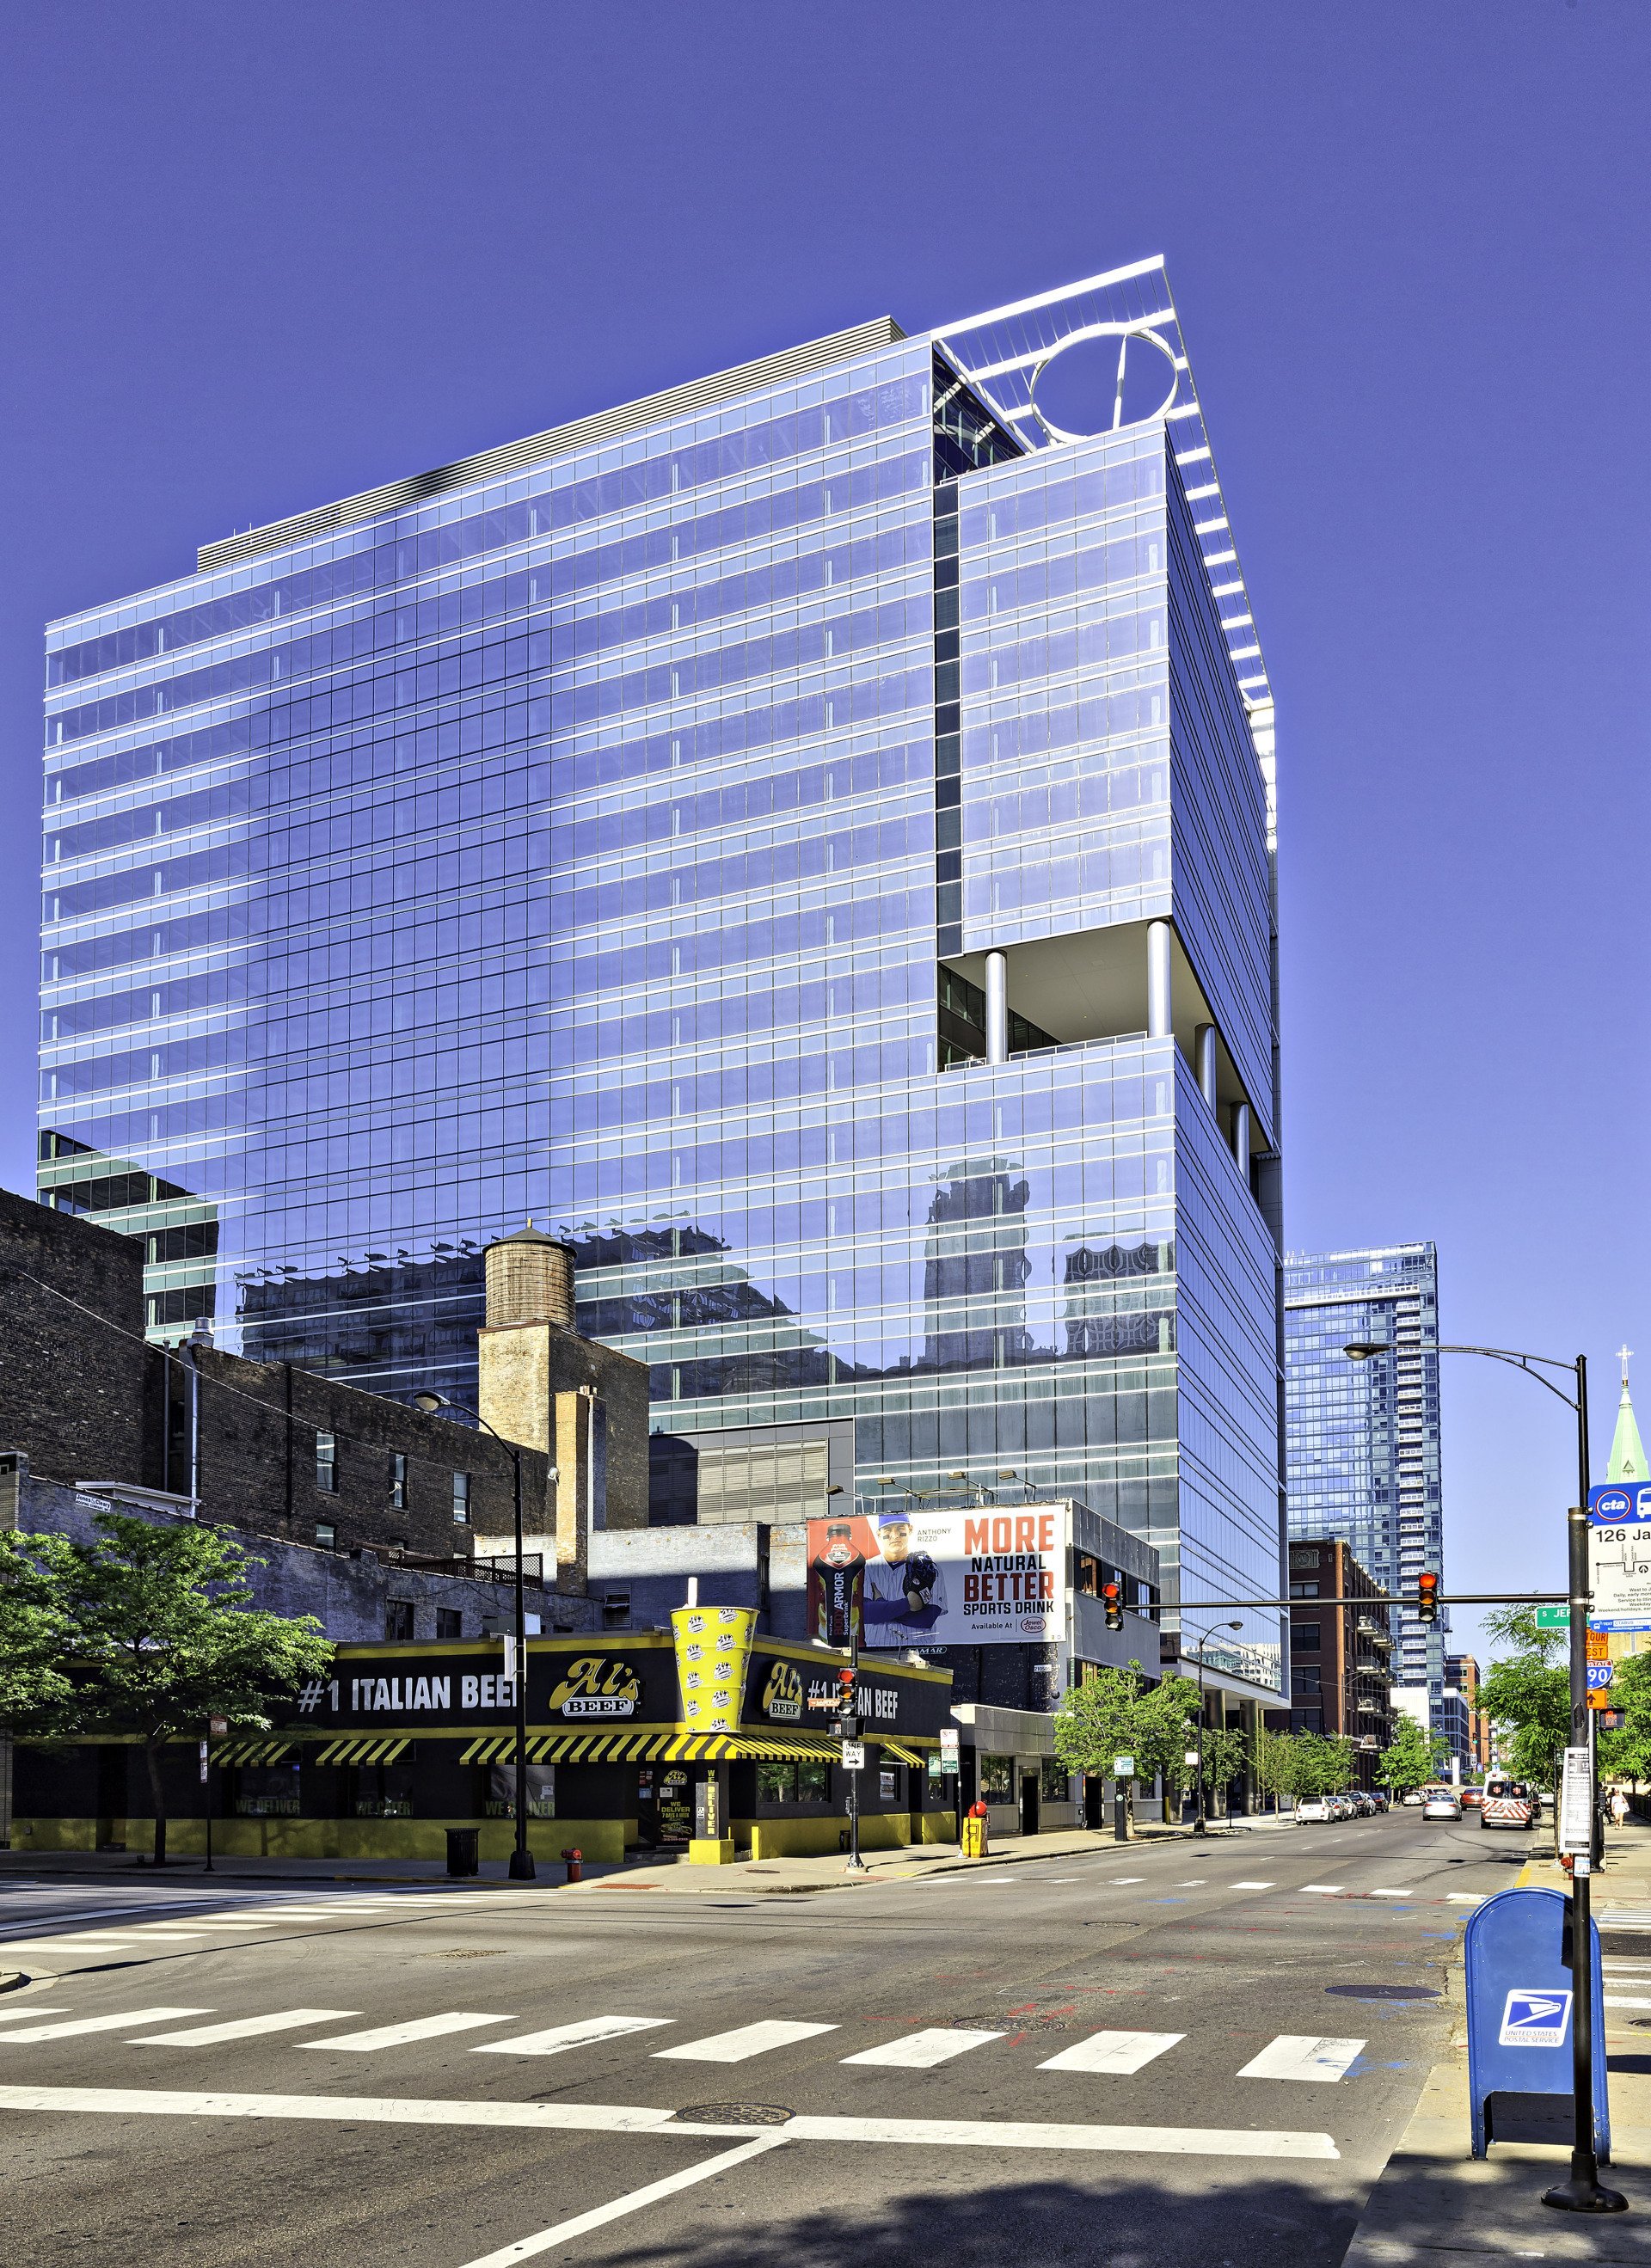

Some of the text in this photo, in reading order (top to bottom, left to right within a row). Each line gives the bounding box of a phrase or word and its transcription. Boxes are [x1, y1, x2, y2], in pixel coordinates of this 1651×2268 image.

[1601, 1499, 1625, 1511] cta
[965, 1515, 1055, 1555] MORE
[1596, 1529, 1651, 1542] 126 Ja
[972, 1554, 1046, 1572] NATURAL
[964, 1572, 1054, 1602] BETTER
[964, 1601, 1054, 1616] SPORTS DRINK
[1587, 1669, 1608, 1683] 90
[549, 1658, 641, 1710] Al's
[763, 1661, 803, 1711] Al's
[298, 1679, 340, 1713] #1
[352, 1676, 451, 1711] ITALIAN
[807, 1679, 827, 1713] #1
[875, 1689, 899, 1719] BEEF
[568, 1700, 629, 1713] BEEF
[771, 1702, 799, 1716] BEEF
[235, 1799, 253, 1813] WE
[356, 1801, 372, 1816] WE
[485, 1801, 504, 1816] WE
[707, 1769, 715, 1835] WE DELIVER
